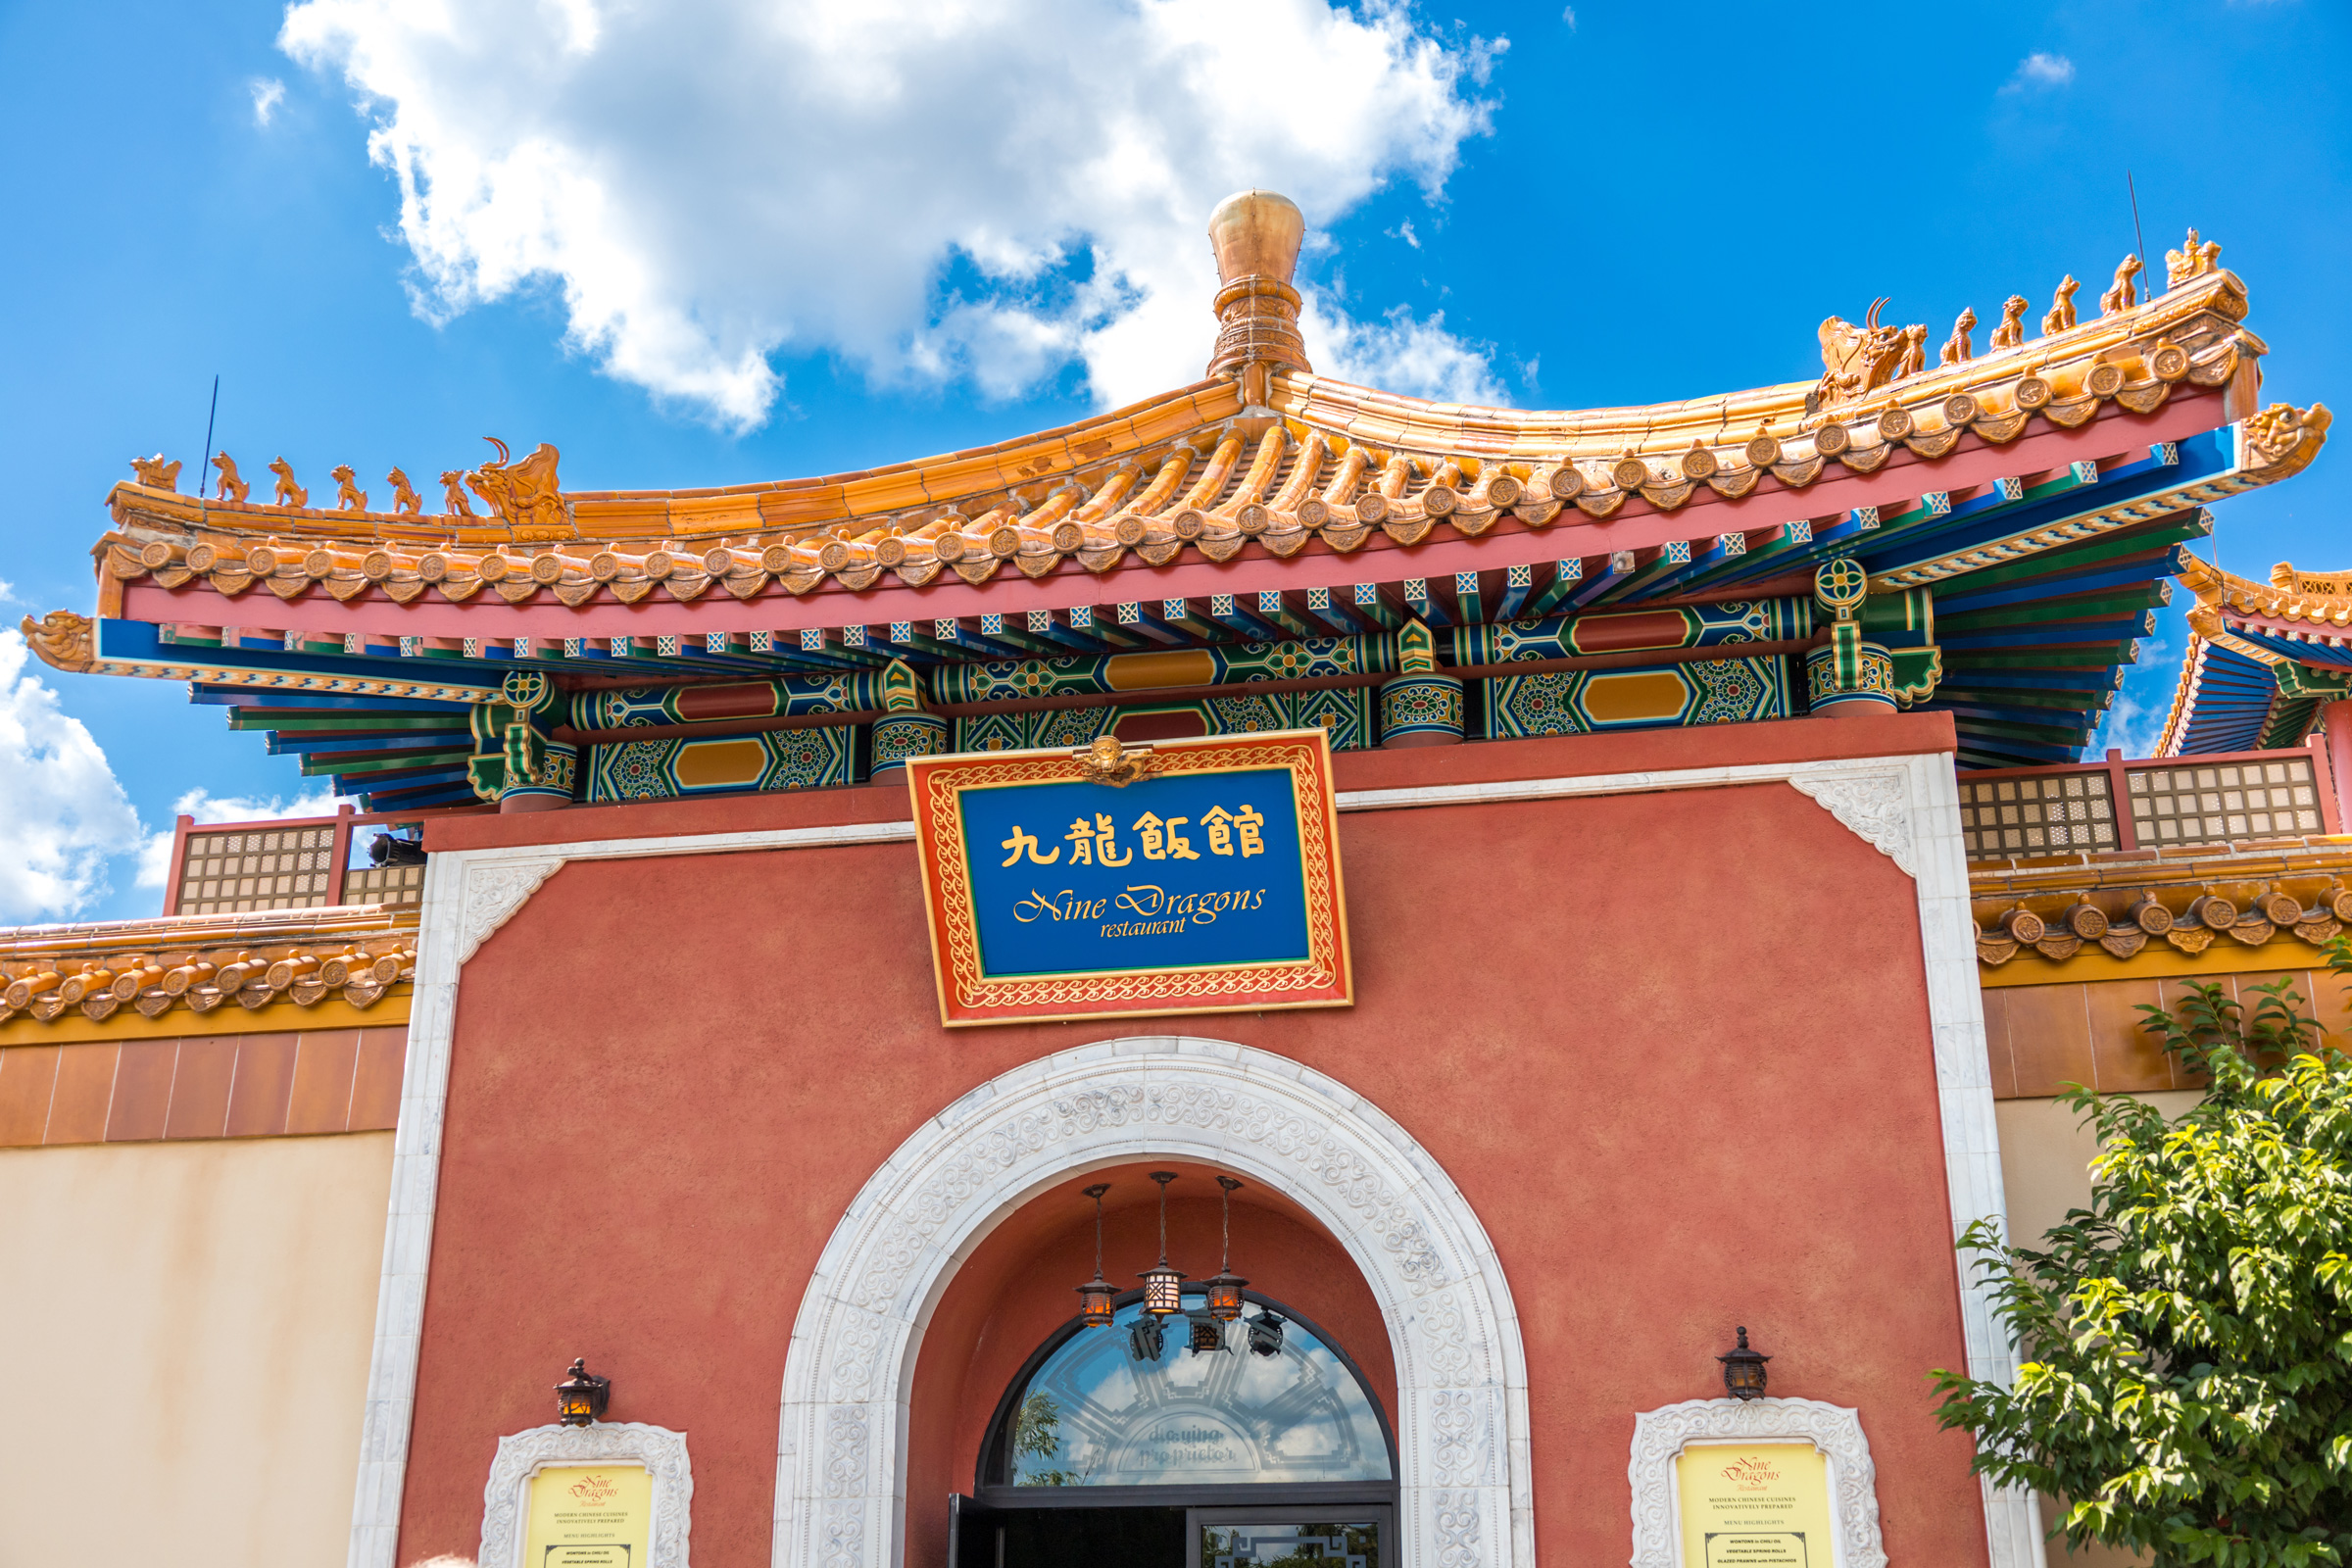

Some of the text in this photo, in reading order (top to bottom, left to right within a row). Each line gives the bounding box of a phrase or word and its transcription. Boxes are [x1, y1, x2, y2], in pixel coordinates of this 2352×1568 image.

[1001, 804, 1265, 868] 九龍飯館
[1012, 884, 1266, 925] Nine Dragons
[1100, 916, 1187, 938] restaurant
[1733, 1456, 1771, 1471] Nine
[578, 1475, 612, 1488] Nine
[1720, 1467, 1781, 1486] Dragons
[567, 1484, 619, 1502] Dragons
